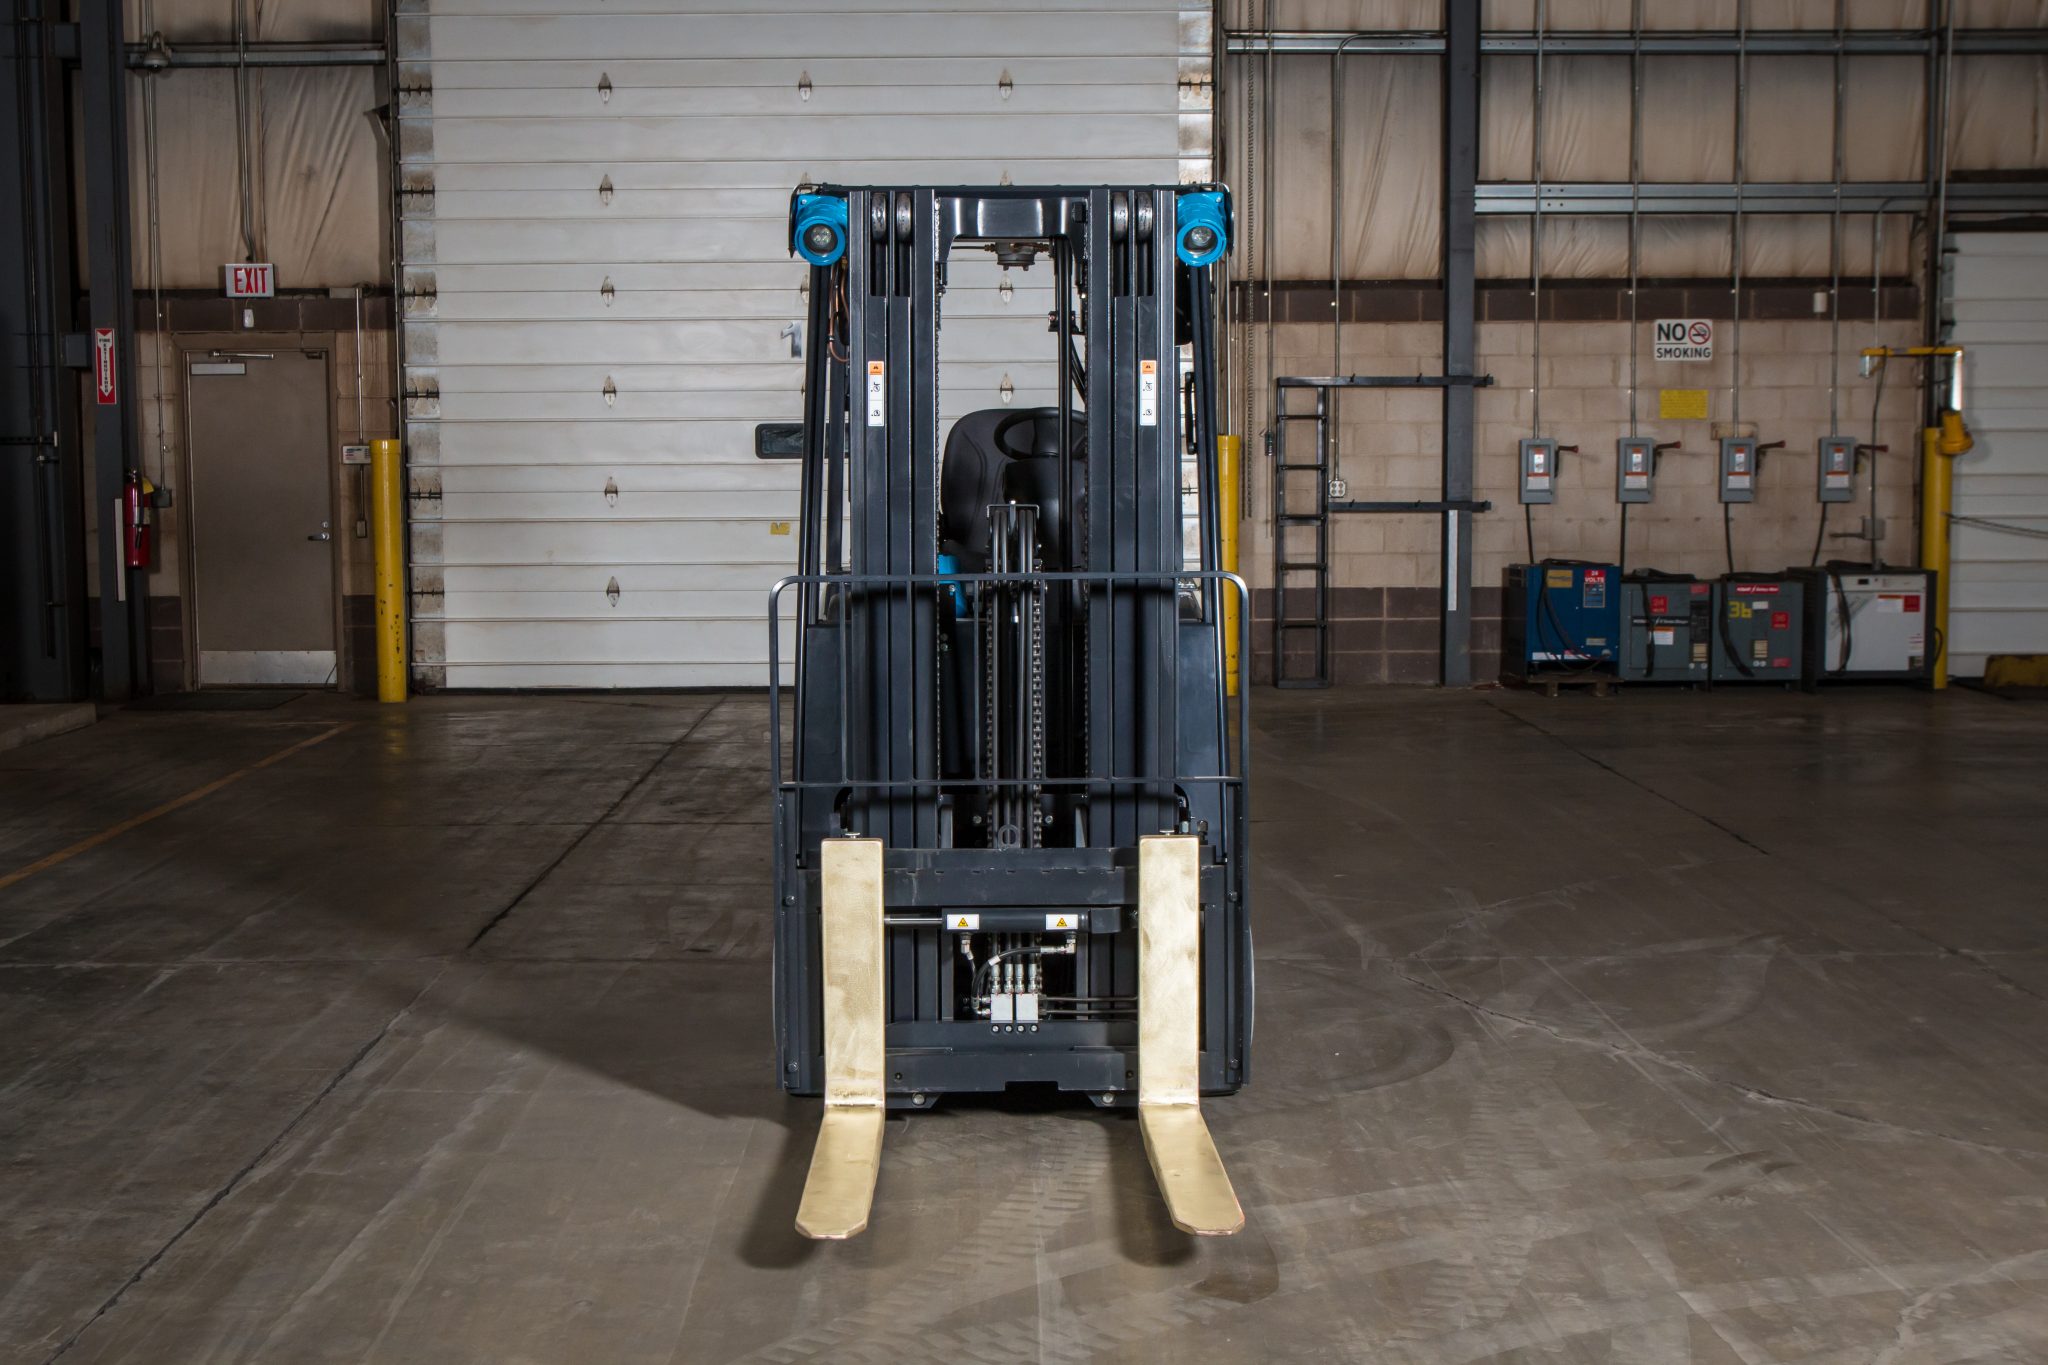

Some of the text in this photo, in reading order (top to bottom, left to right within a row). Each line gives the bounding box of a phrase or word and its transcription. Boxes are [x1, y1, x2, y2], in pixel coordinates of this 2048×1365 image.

[233, 267, 268, 294] EXIT
[780, 320, 802, 358] 1
[1657, 323, 1686, 341] NO
[1656, 347, 1712, 358] SMOKING
